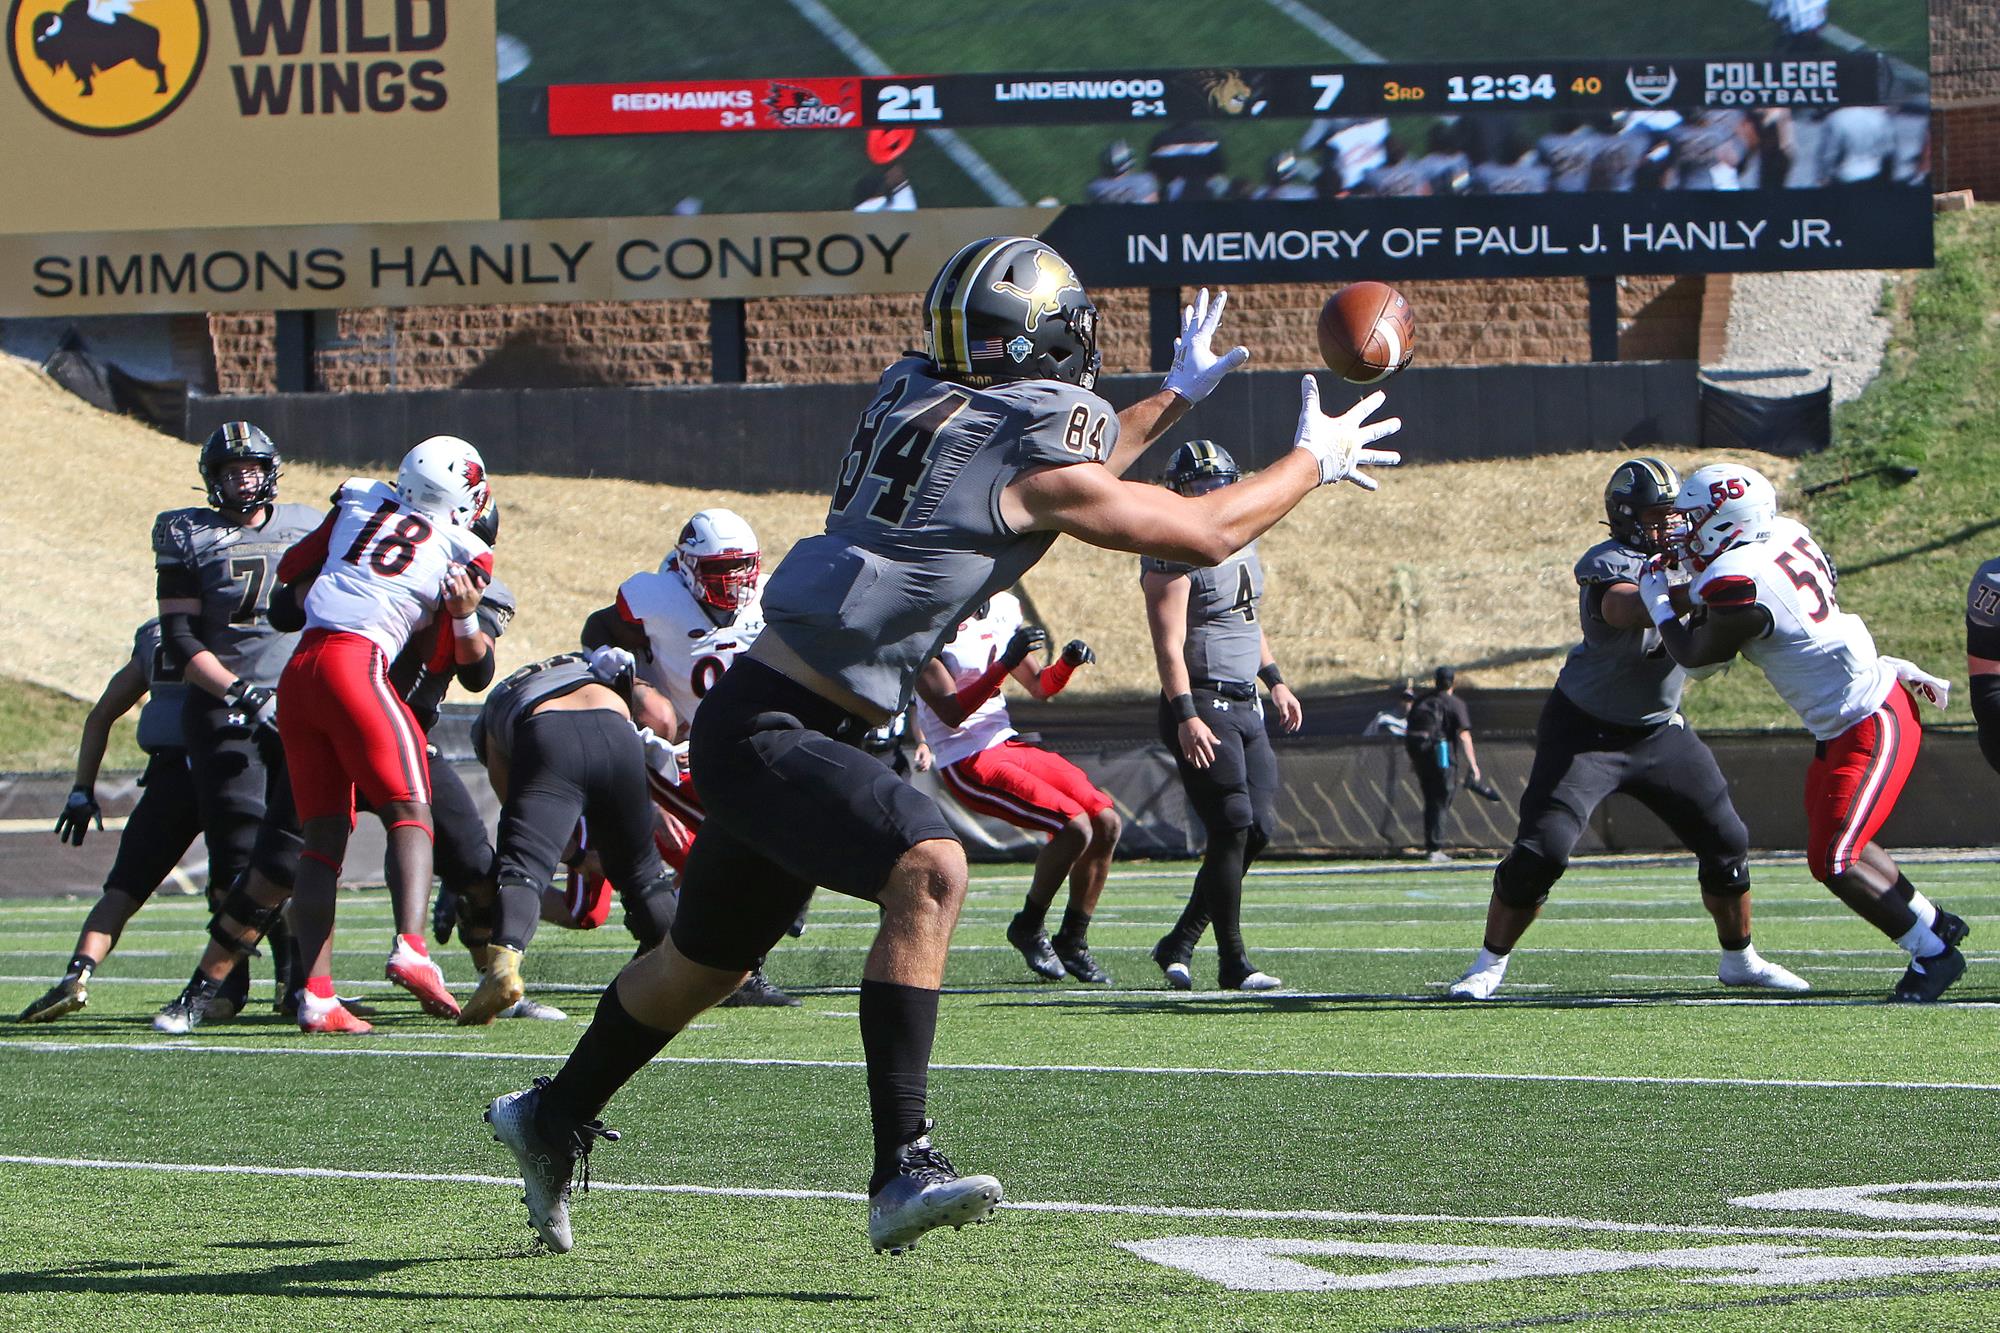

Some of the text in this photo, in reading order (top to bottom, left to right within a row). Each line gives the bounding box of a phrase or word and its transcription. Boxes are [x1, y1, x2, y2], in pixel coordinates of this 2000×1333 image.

[230, 0, 447, 56] WILD
[229, 60, 448, 116] WINGS
[995, 79, 1165, 101] LINDENWOOD
[1383, 82, 1425, 101] 3RD
[1447, 73, 1556, 103] 12:34
[1570, 76, 1602, 96] 40
[1705, 61, 1838, 90] COLLEGE
[612, 89, 753, 112] REDHAWKS
[877, 84, 943, 122] 21
[1131, 100, 1167, 117] 2-1
[1310, 74, 1345, 111] 7
[1705, 90, 1840, 106] FOOTBALL
[720, 110, 756, 128] 3-1
[783, 106, 841, 126] SEMO
[1127, 219, 1843, 263] IN MEMORY OF PAUL J. HANLY JR.
[33, 232, 911, 297] SIMMONS HANLY CONROY
[1062, 401, 1109, 463] 84
[831, 374, 972, 527] 84
[1709, 478, 1746, 503] 55
[341, 497, 433, 577] 18
[228, 555, 279, 628] 7
[1229, 561, 1257, 624] 4
[1973, 584, 2000, 616] 77
